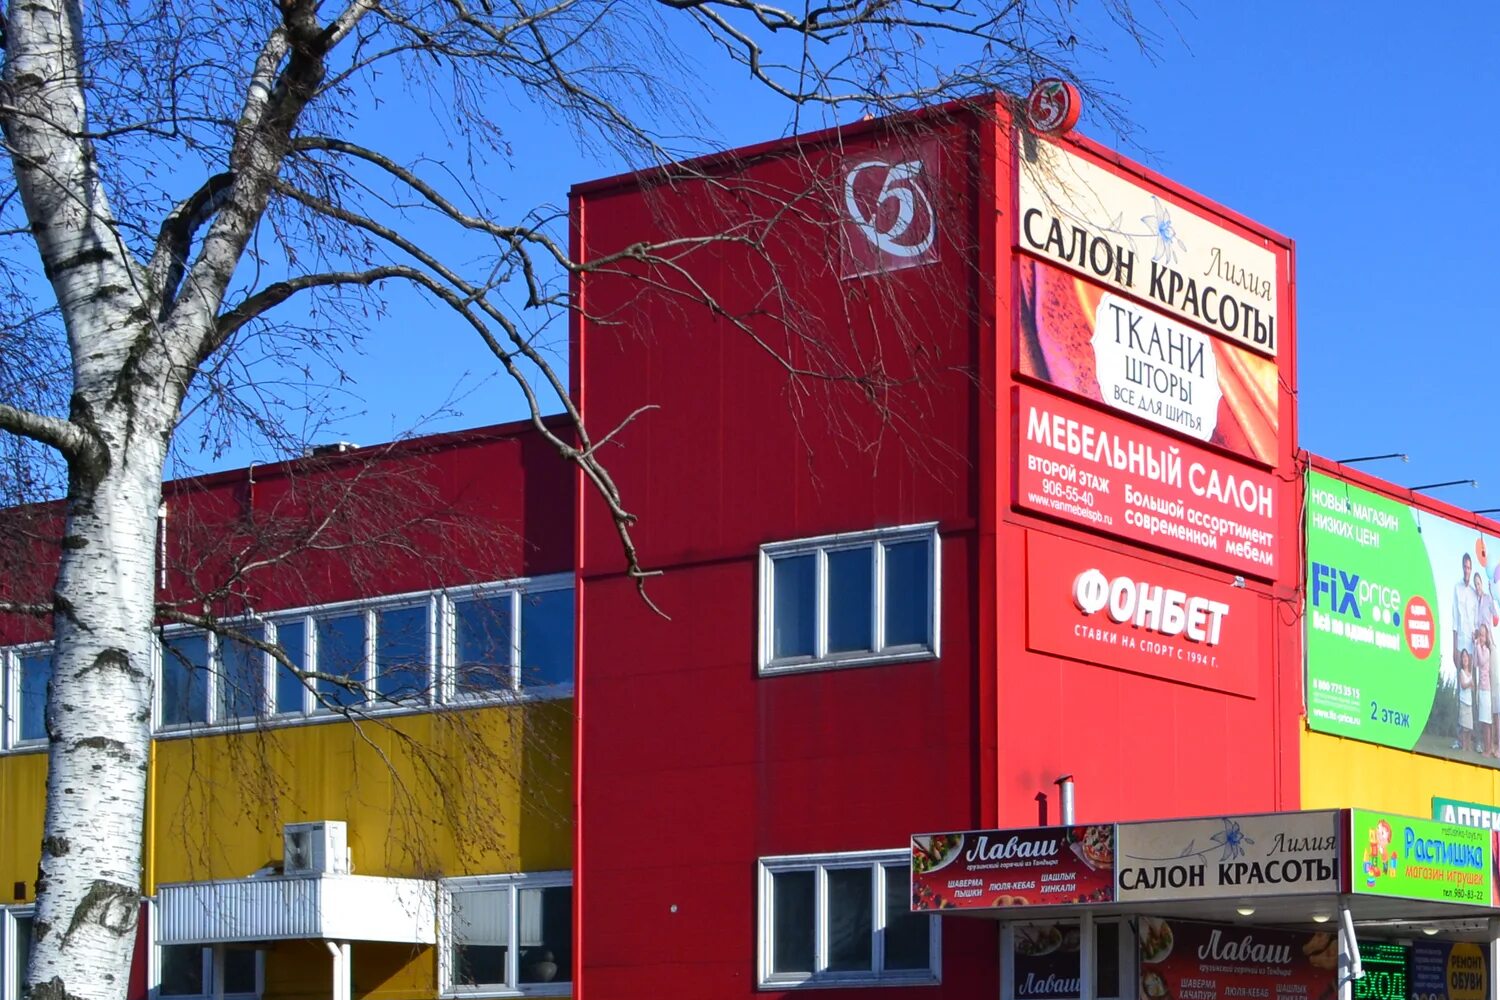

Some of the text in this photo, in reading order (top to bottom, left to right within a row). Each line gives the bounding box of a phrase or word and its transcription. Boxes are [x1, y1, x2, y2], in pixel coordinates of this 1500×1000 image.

[1023, 207, 1275, 349] САЛОН КРАСОТЫ
[1203, 247, 1273, 301] Лилия
[1108, 302, 1206, 379] ТКАНИ
[1125, 355, 1193, 405] ШТОРЫ
[1113, 384, 1203, 432] ВСЕ ДЛЯ ШИТЬЯ
[1027, 406, 1273, 518] МЕБЕЛЬНЫЙ САЛОН
[1027, 453, 1110, 494] ВТОРОЙ ЭТАЖ
[1042, 478, 1094, 507] 906-55-40
[1124, 484, 1274, 547] Большой ассортимент
[1312, 488, 1400, 532] НОВЫЙ МАГАЗИН
[1124, 508, 1274, 566] современной мебели
[1312, 513, 1381, 549] НИЗКИХ ЦЕН!
[1072, 568, 1230, 646] ФОНБЕТ
[1074, 623, 1117, 644] СТАВКИ
[1121, 635, 1136, 650] НА
[1139, 639, 1174, 660] СПОРТ
[1186, 651, 1209, 667] 1994
[1370, 701, 1378, 721] 2
[1381, 708, 1410, 728] этаж
[966, 834, 1059, 863] Лаваш
[1266, 832, 1338, 857] Лилия
[1403, 825, 1484, 870] Растишка
[948, 878, 984, 888] ШАВЕРМА
[988, 881, 1036, 892] ЛЮЛЯ-КЕБАБ
[1040, 872, 1077, 882] ШАШЛЫК
[1040, 883, 1076, 894] ХИНКАЛИ
[1118, 857, 1340, 891] САЛОН КРАСОТЫ
[1405, 866, 1484, 887] магазин игрушек
[954, 889, 983, 898] ПЫШКИ
[1198, 928, 1294, 964] Лаваш
[1451, 955, 1482, 968] РЕМОНТ
[1019, 972, 1081, 996] Лаваш
[1179, 989, 1217, 1000] ХАЧАПУРИ
[1180, 978, 1216, 989] ШАВЕРМА
[1224, 986, 1270, 998] ЛЮЛЯ-КЕБАБ
[1275, 983, 1308, 993] ШАШЛЫК
[1451, 973, 1483, 991] ОБУВИ
